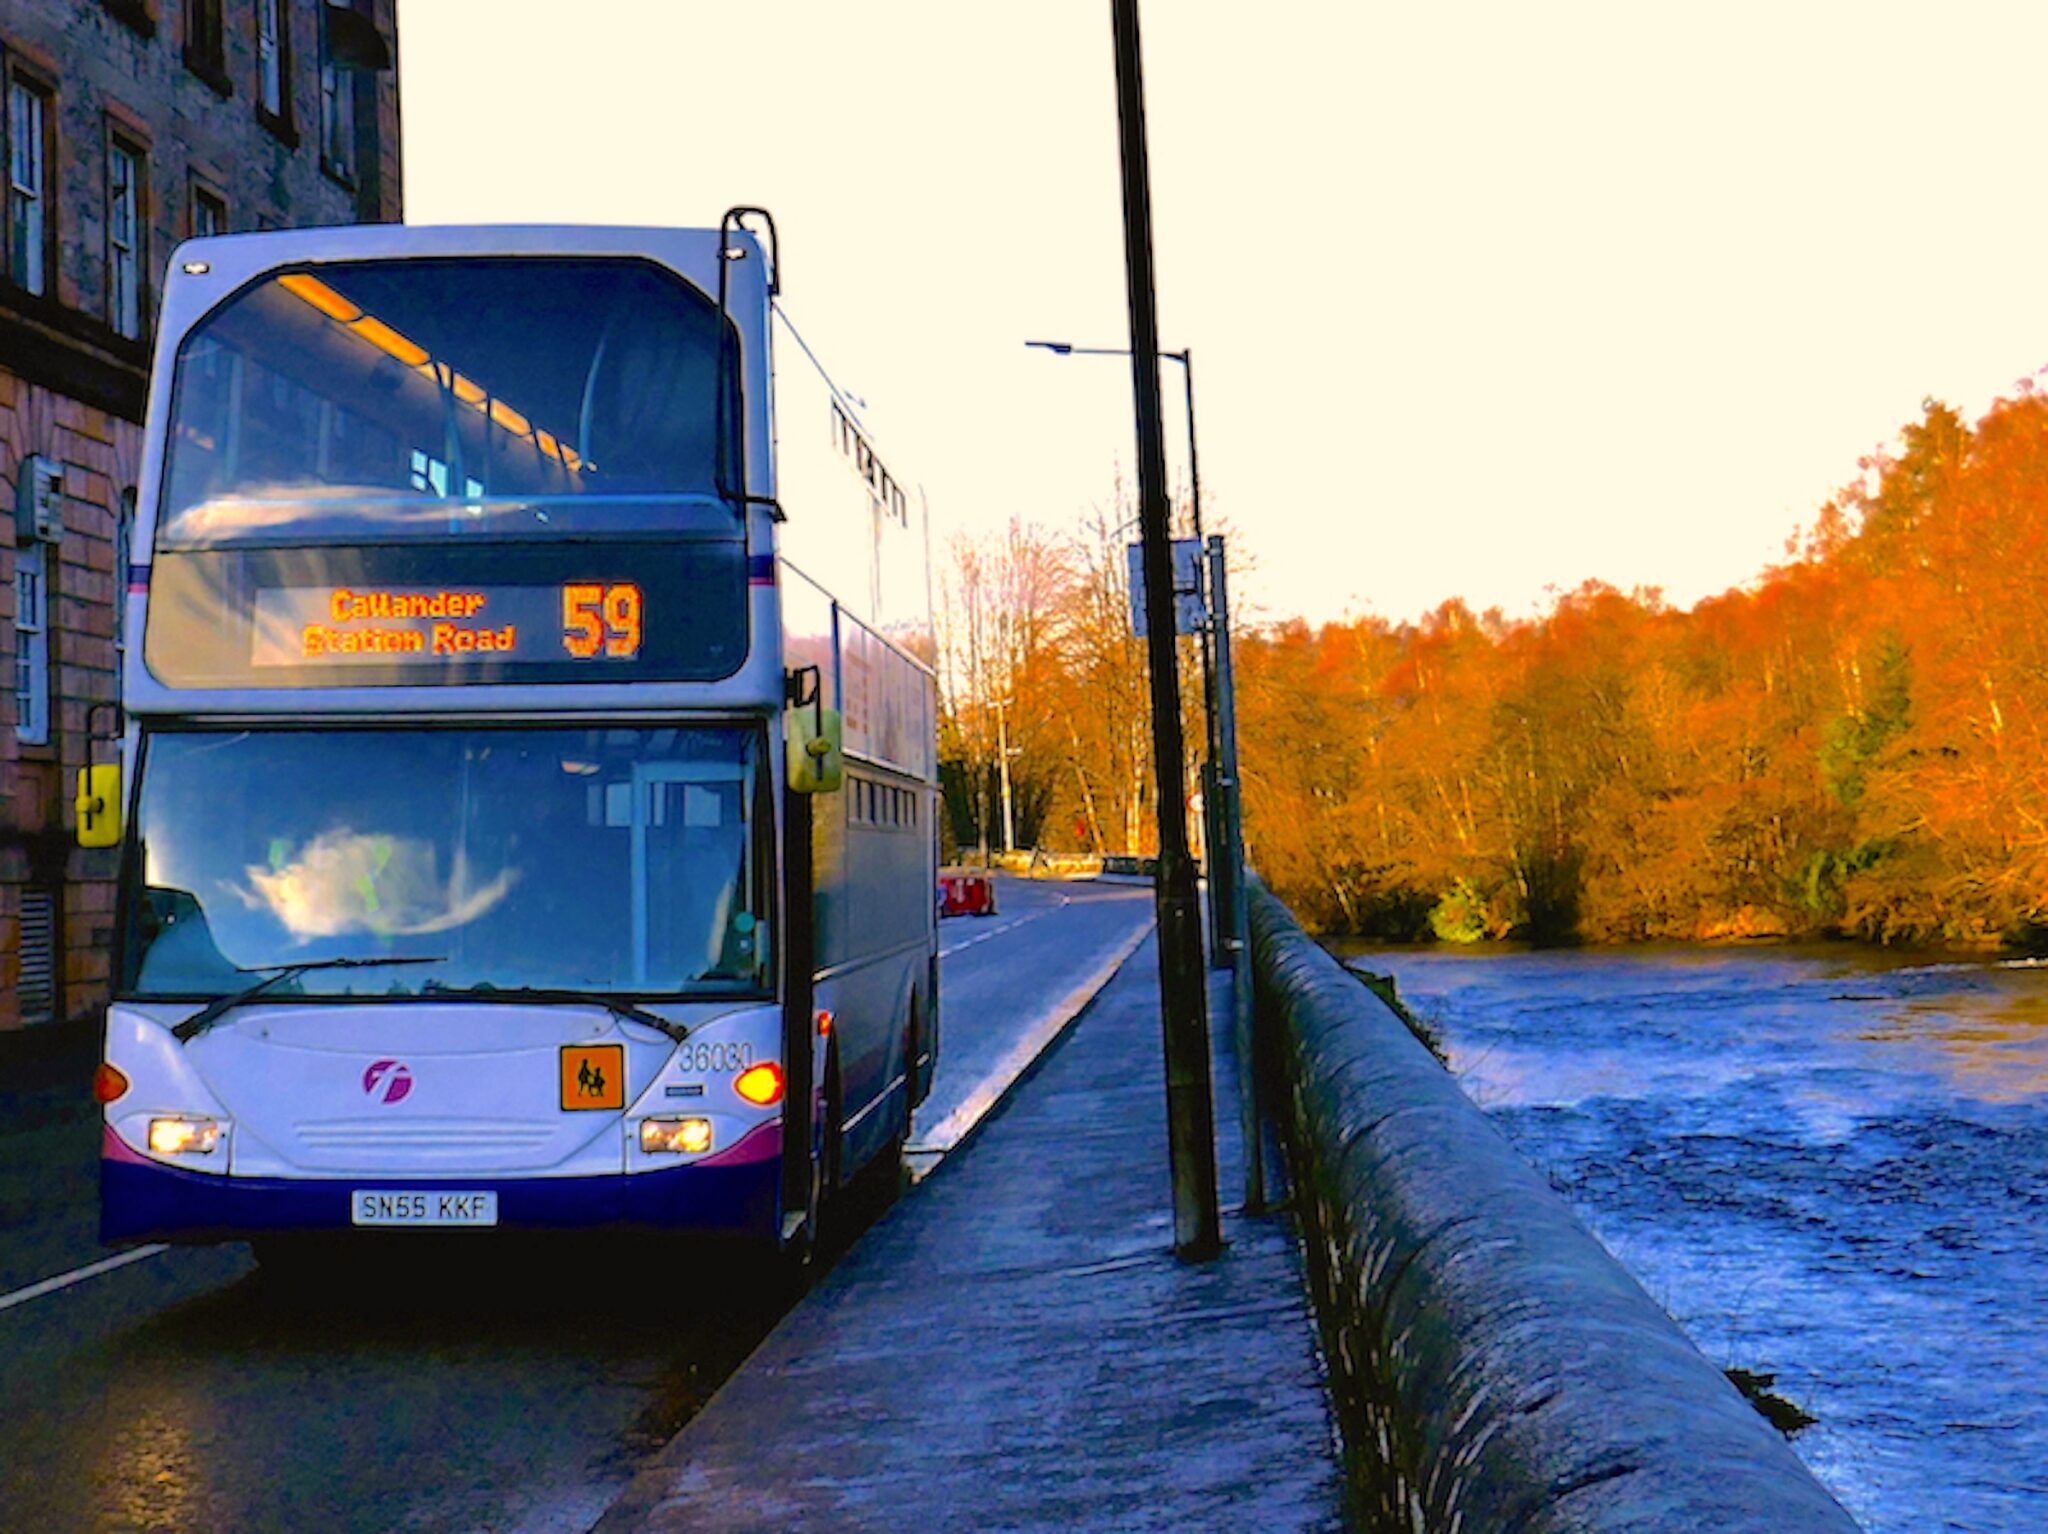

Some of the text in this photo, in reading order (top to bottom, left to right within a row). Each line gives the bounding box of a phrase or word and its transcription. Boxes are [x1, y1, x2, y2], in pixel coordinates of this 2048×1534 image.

[330, 589, 485, 620] Callander
[562, 582, 643, 659] 59
[302, 624, 515, 656] Station Road
[364, 1196, 486, 1219] SN55 KKF
